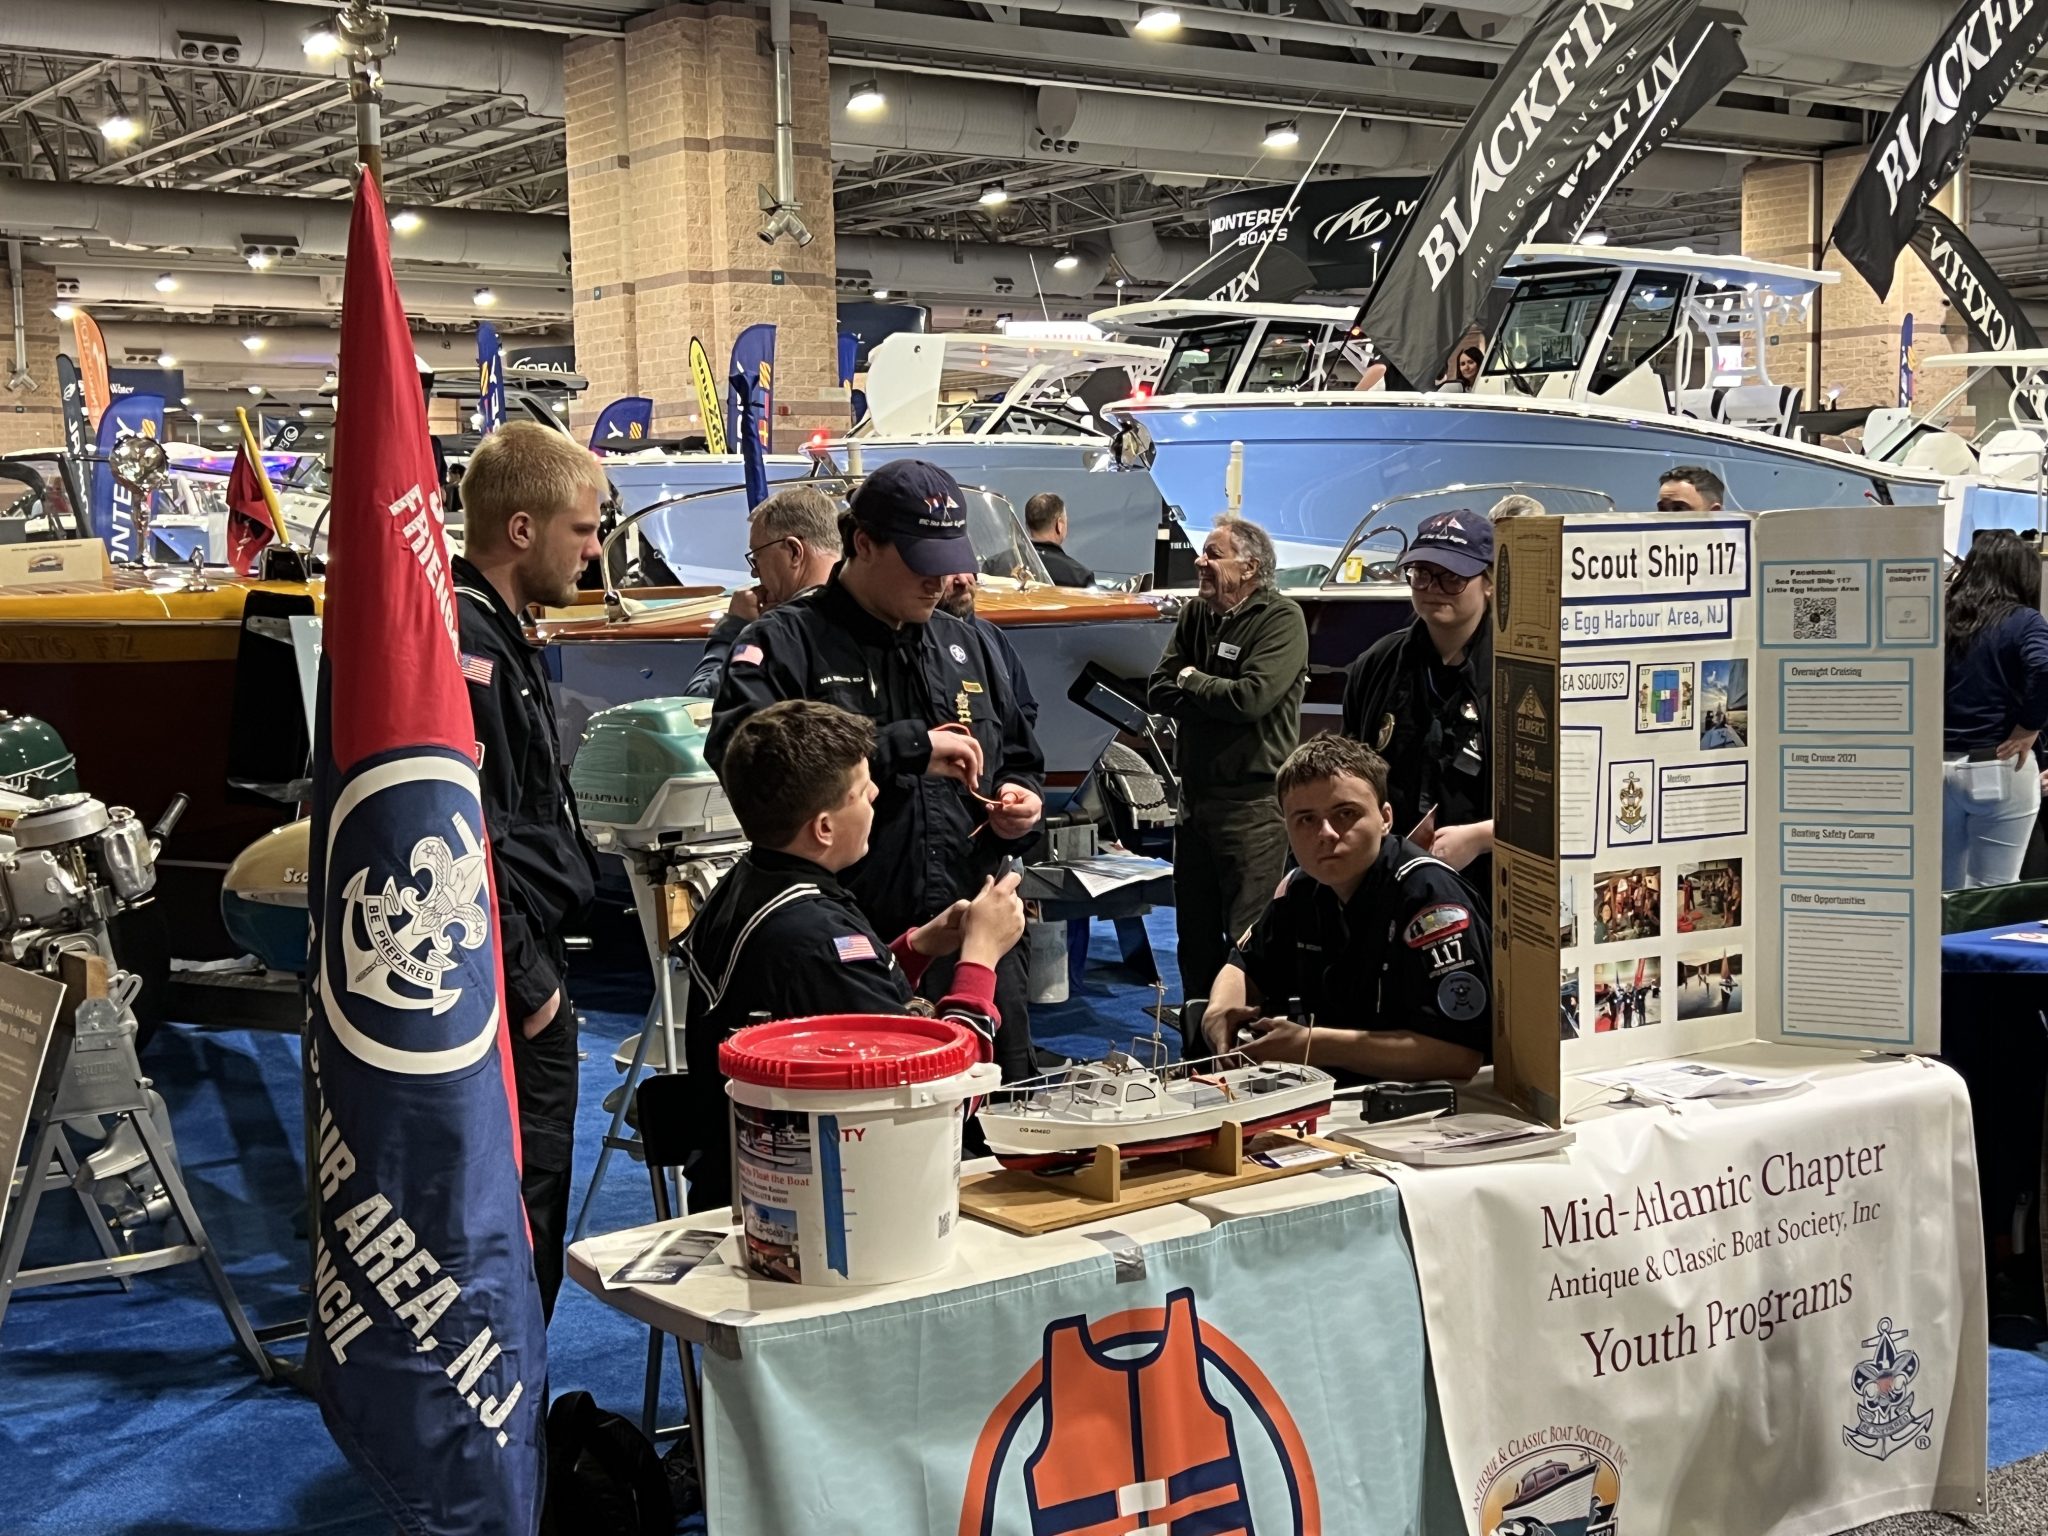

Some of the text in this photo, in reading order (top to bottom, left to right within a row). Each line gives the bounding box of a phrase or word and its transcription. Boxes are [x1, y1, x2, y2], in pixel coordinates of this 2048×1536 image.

[1876, 0, 2034, 216] BLACKFI
[1660, 117, 1679, 137] ON
[1471, 47, 1637, 279] THE LEGEND LIVES ON
[1211, 206, 1301, 234] MONTEREY
[1238, 228, 1288, 246] BOATS
[1571, 542, 1737, 585] Scout Ship 117
[1574, 611, 1600, 634] Egg
[1604, 608, 1661, 629] Harbour
[1667, 606, 1703, 627] Area,
[1707, 604, 1724, 624] NJ
[1578, 672, 1625, 691] SCOUTS?
[1791, 667, 1862, 678] Overnight Cruising
[1791, 752, 1810, 764] Long
[1837, 753, 1857, 763] 2021
[1822, 829, 1847, 840] Safety
[1791, 893, 1866, 905] Other Opportunities
[369, 905, 434, 981] BE PREPARED
[1431, 940, 1463, 968] 117
[786, 1174, 810, 1187] Boat
[1540, 1142, 1887, 1250] Mid-Atlantic Chapter
[1546, 1198, 1881, 1303] Antique & Classic Boat Society, Inc
[334, 1192, 463, 1353] AREA,
[446, 1325, 524, 1449] N.J.
[1581, 1272, 1854, 1379] Youth Programs
[1497, 1447, 1509, 1463] &
[1508, 1429, 1549, 1458] CLASSIC
[1549, 1425, 1574, 1442] BOAT
